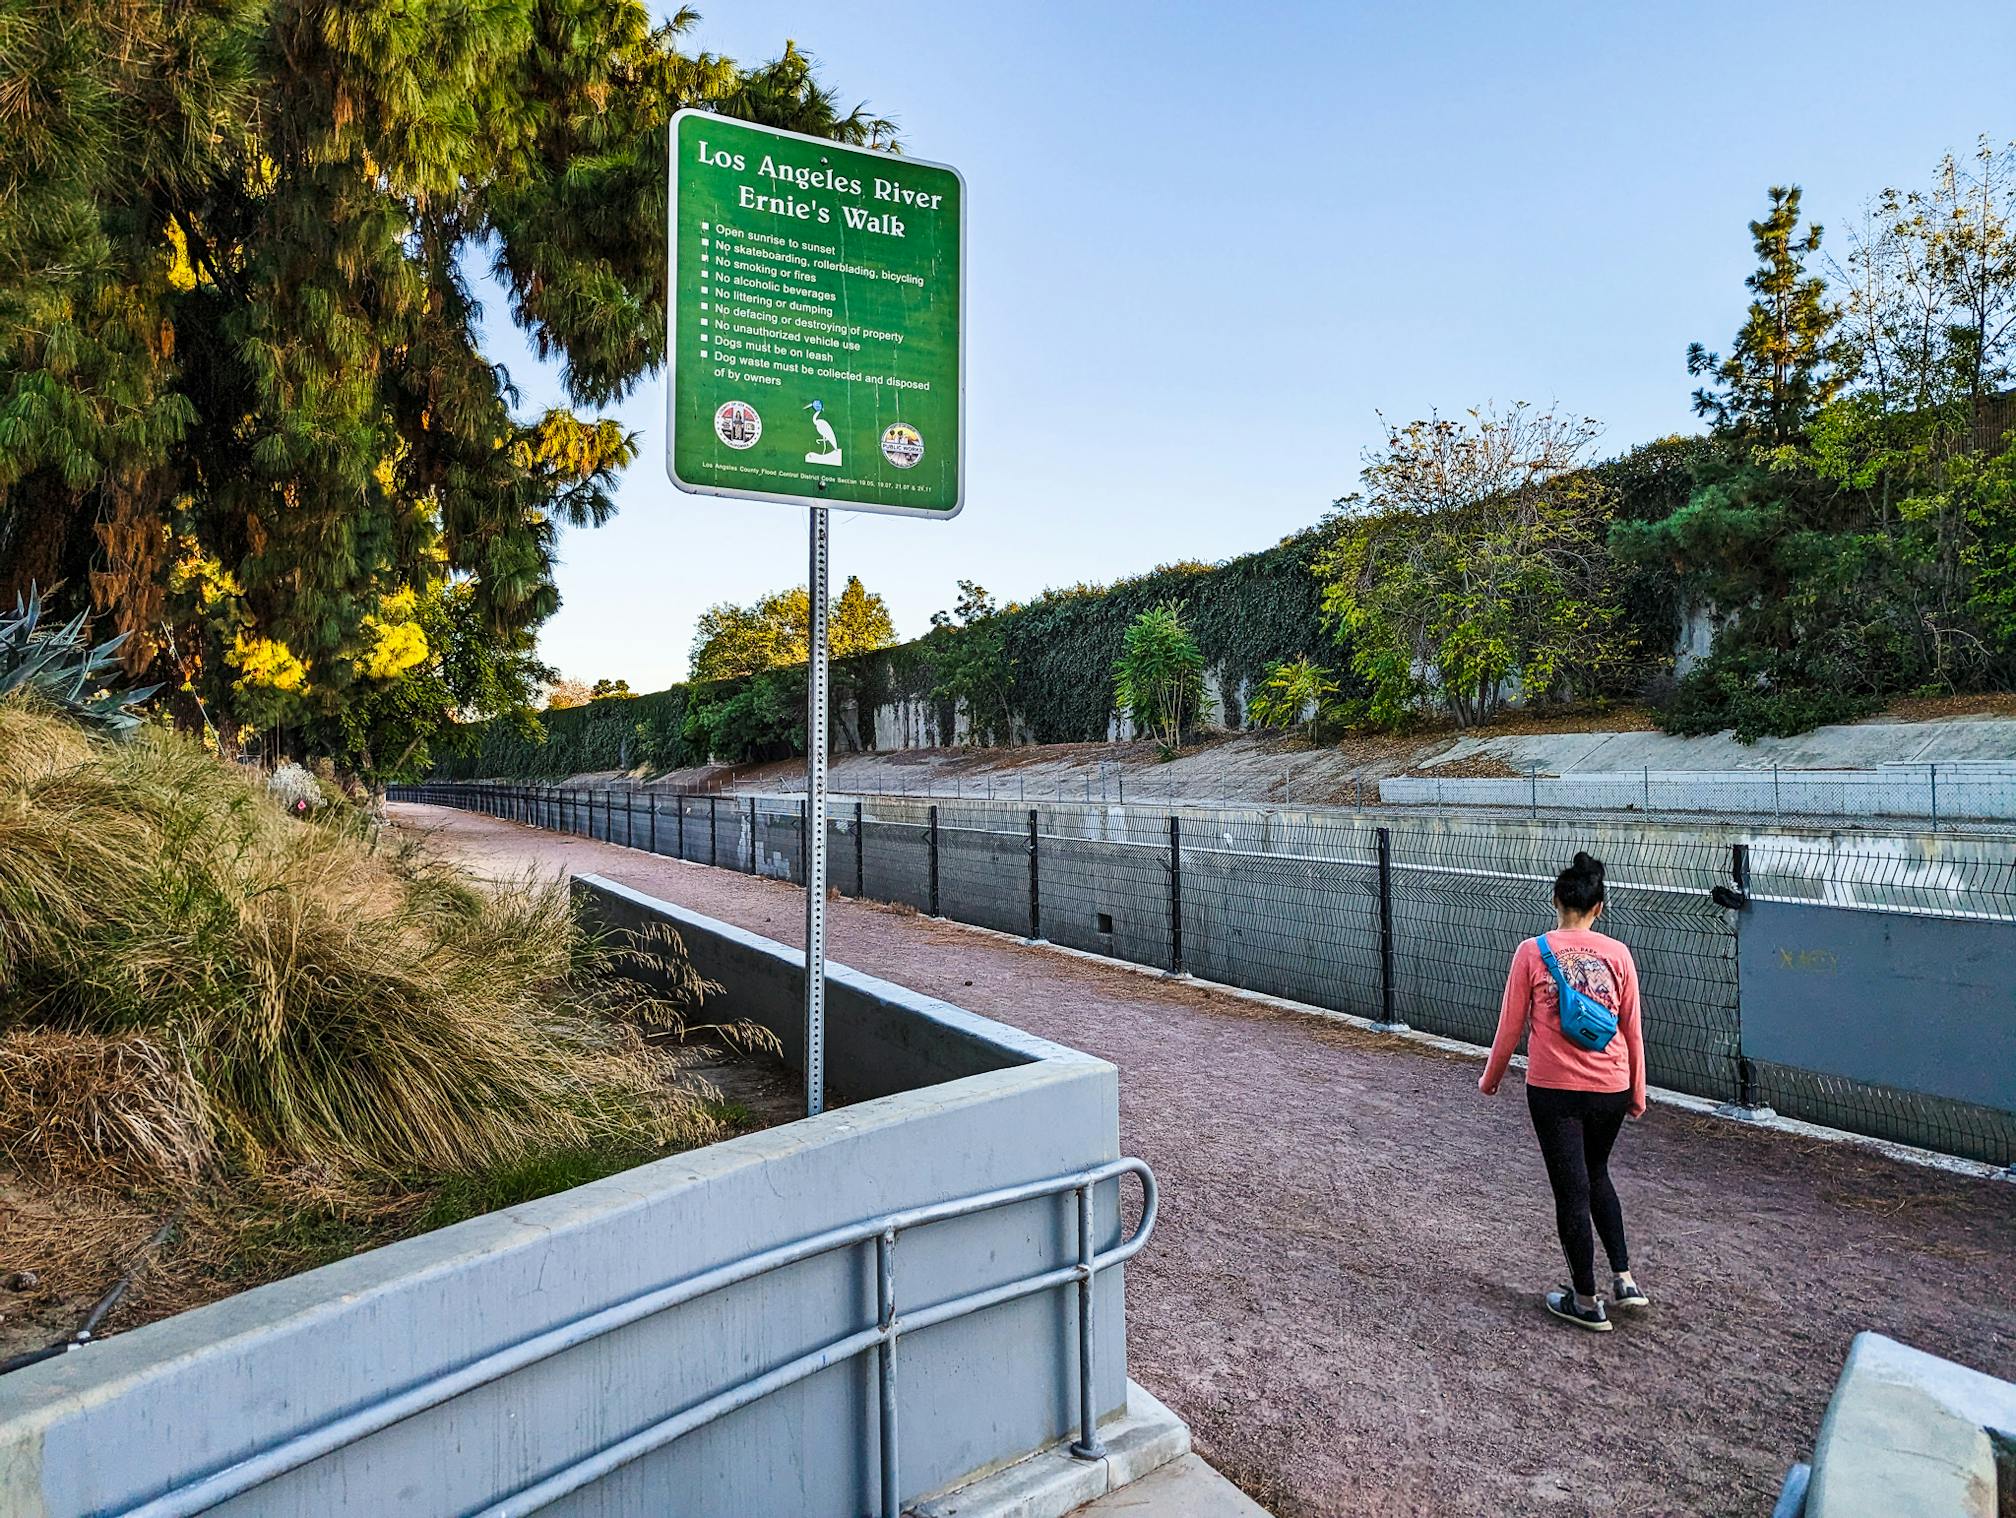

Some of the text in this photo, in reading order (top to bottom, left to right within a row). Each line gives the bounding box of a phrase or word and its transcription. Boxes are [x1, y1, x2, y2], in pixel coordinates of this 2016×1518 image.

[698, 140, 942, 210] Los Angeles River
[738, 185, 906, 238] Ernie's Walk
[716, 224, 836, 256] Open sunrise to sunset
[716, 240, 924, 287] No skateboarding, rollerblading, bicycling
[716, 256, 817, 283] No smoking or fires
[716, 272, 836, 302] No alcoholic beverages
[715, 288, 833, 318] No littering or dumping
[715, 304, 904, 344] No defacing or destroying of property
[715, 320, 861, 352] No unauthorized vehicle use
[714, 336, 834, 362] Dogs must be on leash
[714, 351, 930, 391] Dog waste must be collected and disposed
[714, 368, 782, 386] of by owners
[740, 466, 759, 475] County
[800, 473, 820, 481] District
[1555, 948, 1598, 958] TIONAL PARK
